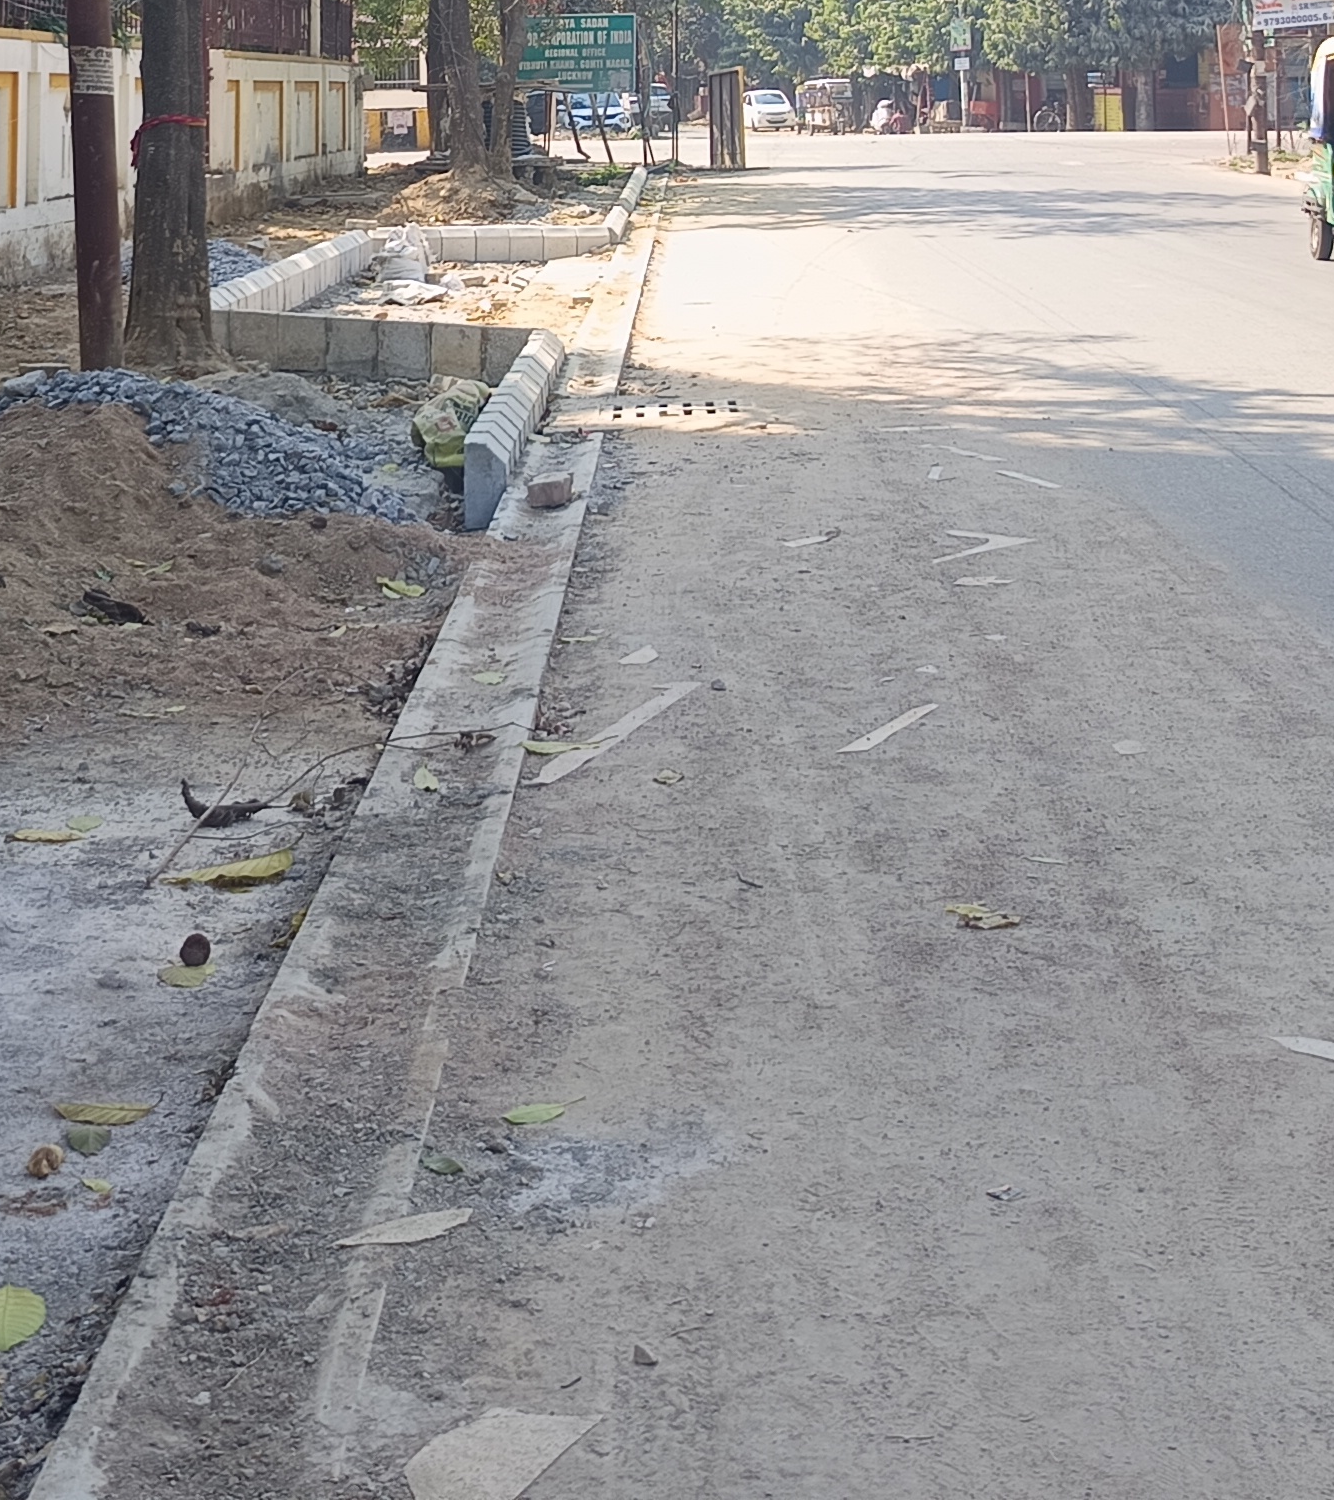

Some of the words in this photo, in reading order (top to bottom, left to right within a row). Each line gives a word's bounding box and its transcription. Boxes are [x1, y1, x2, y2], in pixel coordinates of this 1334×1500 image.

[581, 18, 609, 28] SADAN
[597, 31, 607, 45] OF
[610, 30, 632, 44] INDIA
[545, 48, 579, 58] REGIONAL
[582, 48, 606, 57] OFFICE
[580, 59, 603, 68] GOMTI
[557, 70, 593, 80] LUCKNOW
